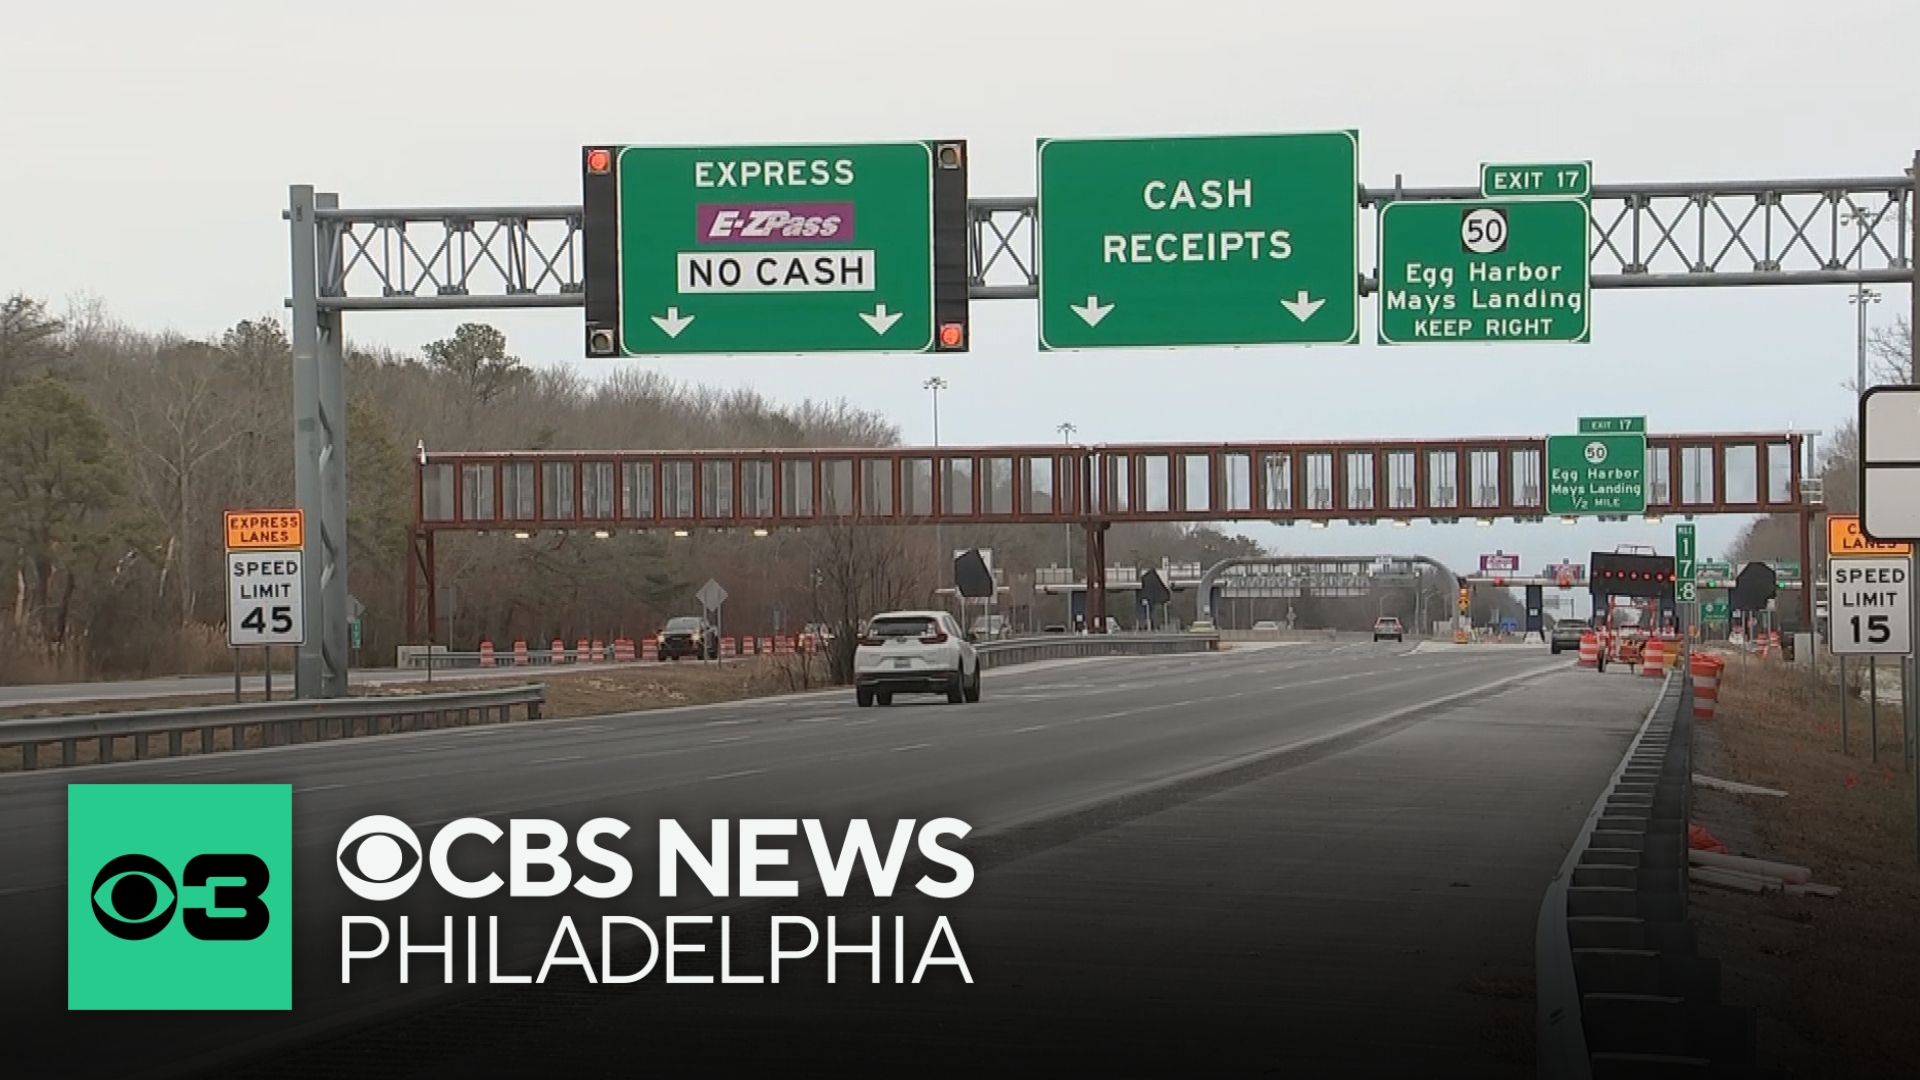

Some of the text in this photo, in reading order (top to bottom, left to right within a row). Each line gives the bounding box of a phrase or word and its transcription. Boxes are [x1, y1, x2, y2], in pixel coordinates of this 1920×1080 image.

[695, 159, 854, 187] EXPRESS
[1494, 170, 1580, 190] EXIT 17
[1144, 178, 1253, 210] CASH
[708, 210, 842, 238] E-ZPass
[1467, 219, 1502, 243] 50
[1103, 230, 1292, 263] RECEIPTS
[689, 256, 864, 287] NO CASH
[1406, 262, 1562, 289] Egg Harbor
[1387, 289, 1581, 315] Mays Landing
[1415, 318, 1553, 337] KEEP RIGHT
[1591, 419, 1632, 430] EXIT 17
[1587, 447, 1605, 459] 50
[1552, 467, 1639, 483] Egg Harbor
[1551, 483, 1641, 497] Mays Landing
[1594, 499, 1620, 507] MILE
[230, 517, 298, 529] EXPRESS
[241, 531, 289, 542] LANES
[234, 562, 298, 576] SPEED
[1836, 568, 1905, 583] SPEED
[241, 585, 291, 599] LIMIT
[1843, 593, 1898, 607] LIMIT
[241, 606, 293, 634] 45
[1851, 615, 1891, 644] 15
